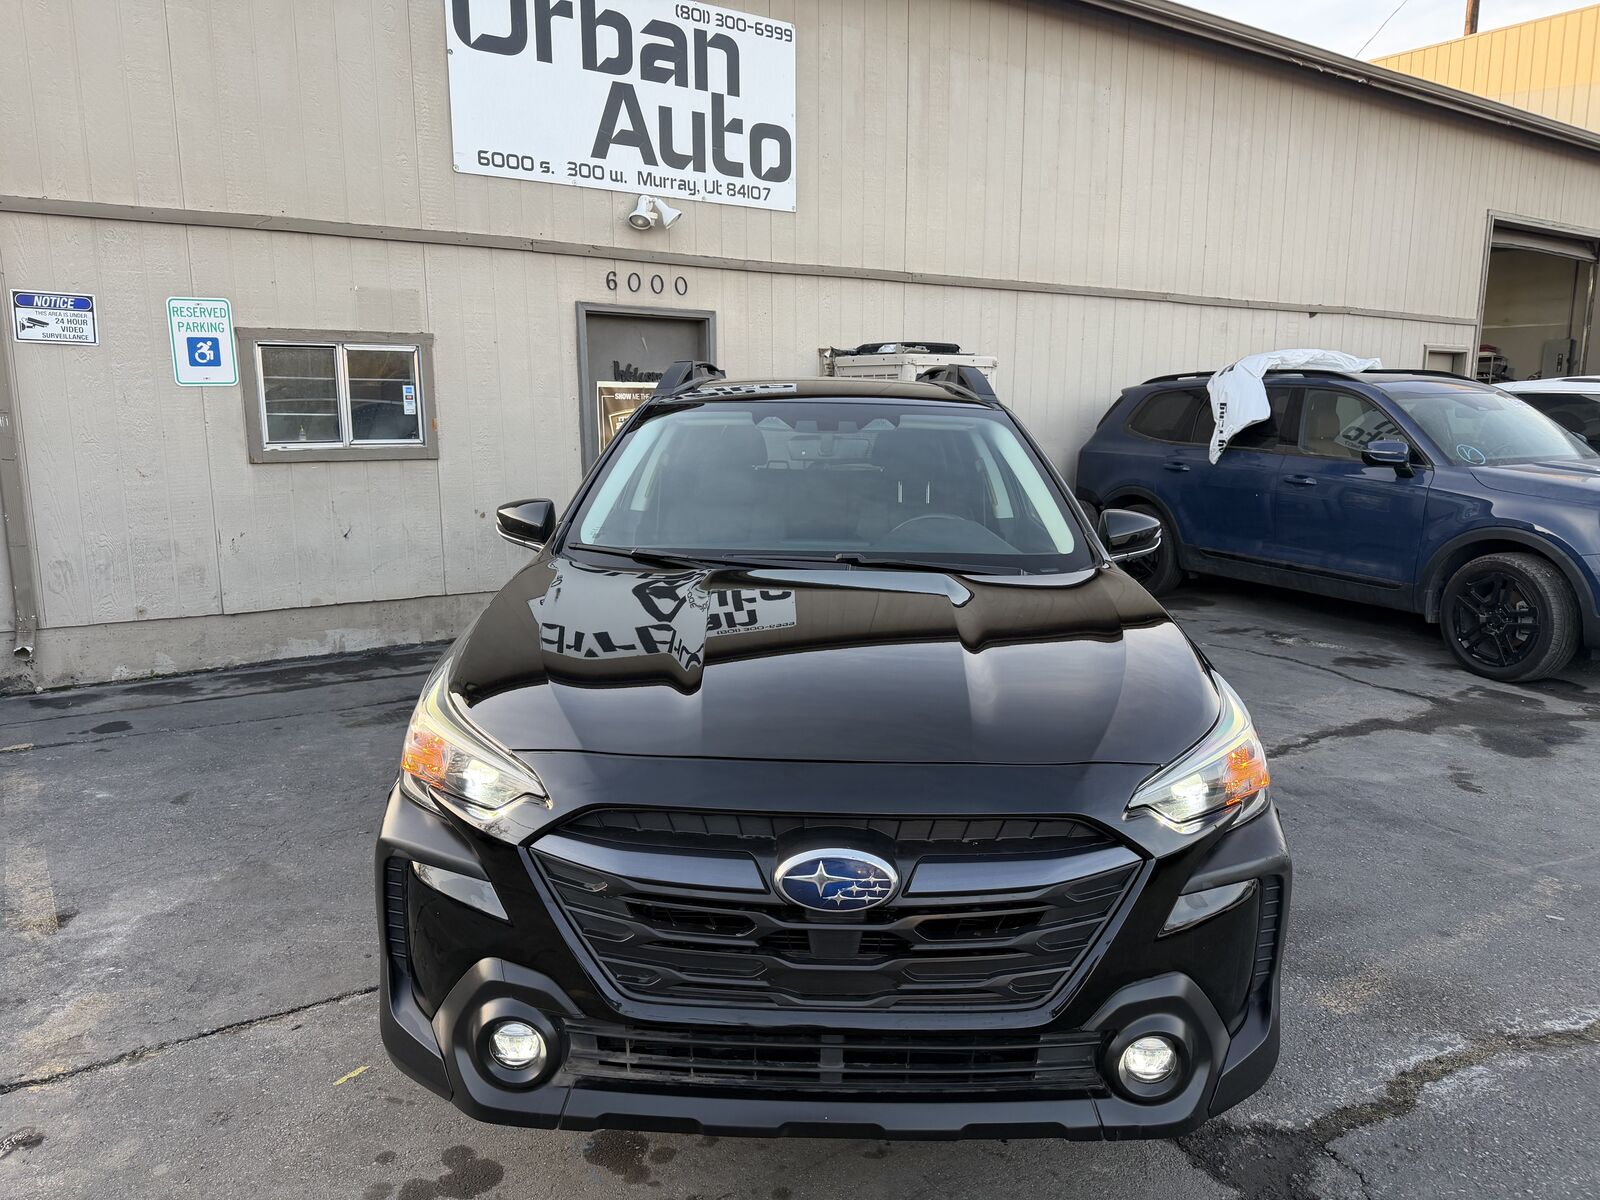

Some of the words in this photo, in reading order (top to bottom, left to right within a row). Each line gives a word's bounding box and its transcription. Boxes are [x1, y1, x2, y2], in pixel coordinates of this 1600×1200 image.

[675, 4, 710, 24] (801)
[715, 13, 793, 43] 300-6999
[452, 0, 740, 97] Urban
[590, 81, 792, 183] Auto
[477, 150, 534, 171] 6000
[567, 161, 605, 180] 300
[637, 170, 700, 196] Murray,
[704, 179, 722, 195] Ut
[726, 182, 771, 201] 84107
[606, 271, 688, 295] 6000
[33, 295, 75, 309] NOTICE
[172, 306, 227, 318] RESERVED
[55, 317, 65, 325] 24
[66, 318, 88, 326] HOUR
[177, 321, 225, 333] PARKING
[42, 332, 89, 341] SURVEILLANCE
[60, 326, 84, 334] VIDEO
[614, 392, 632, 400] SHOW
